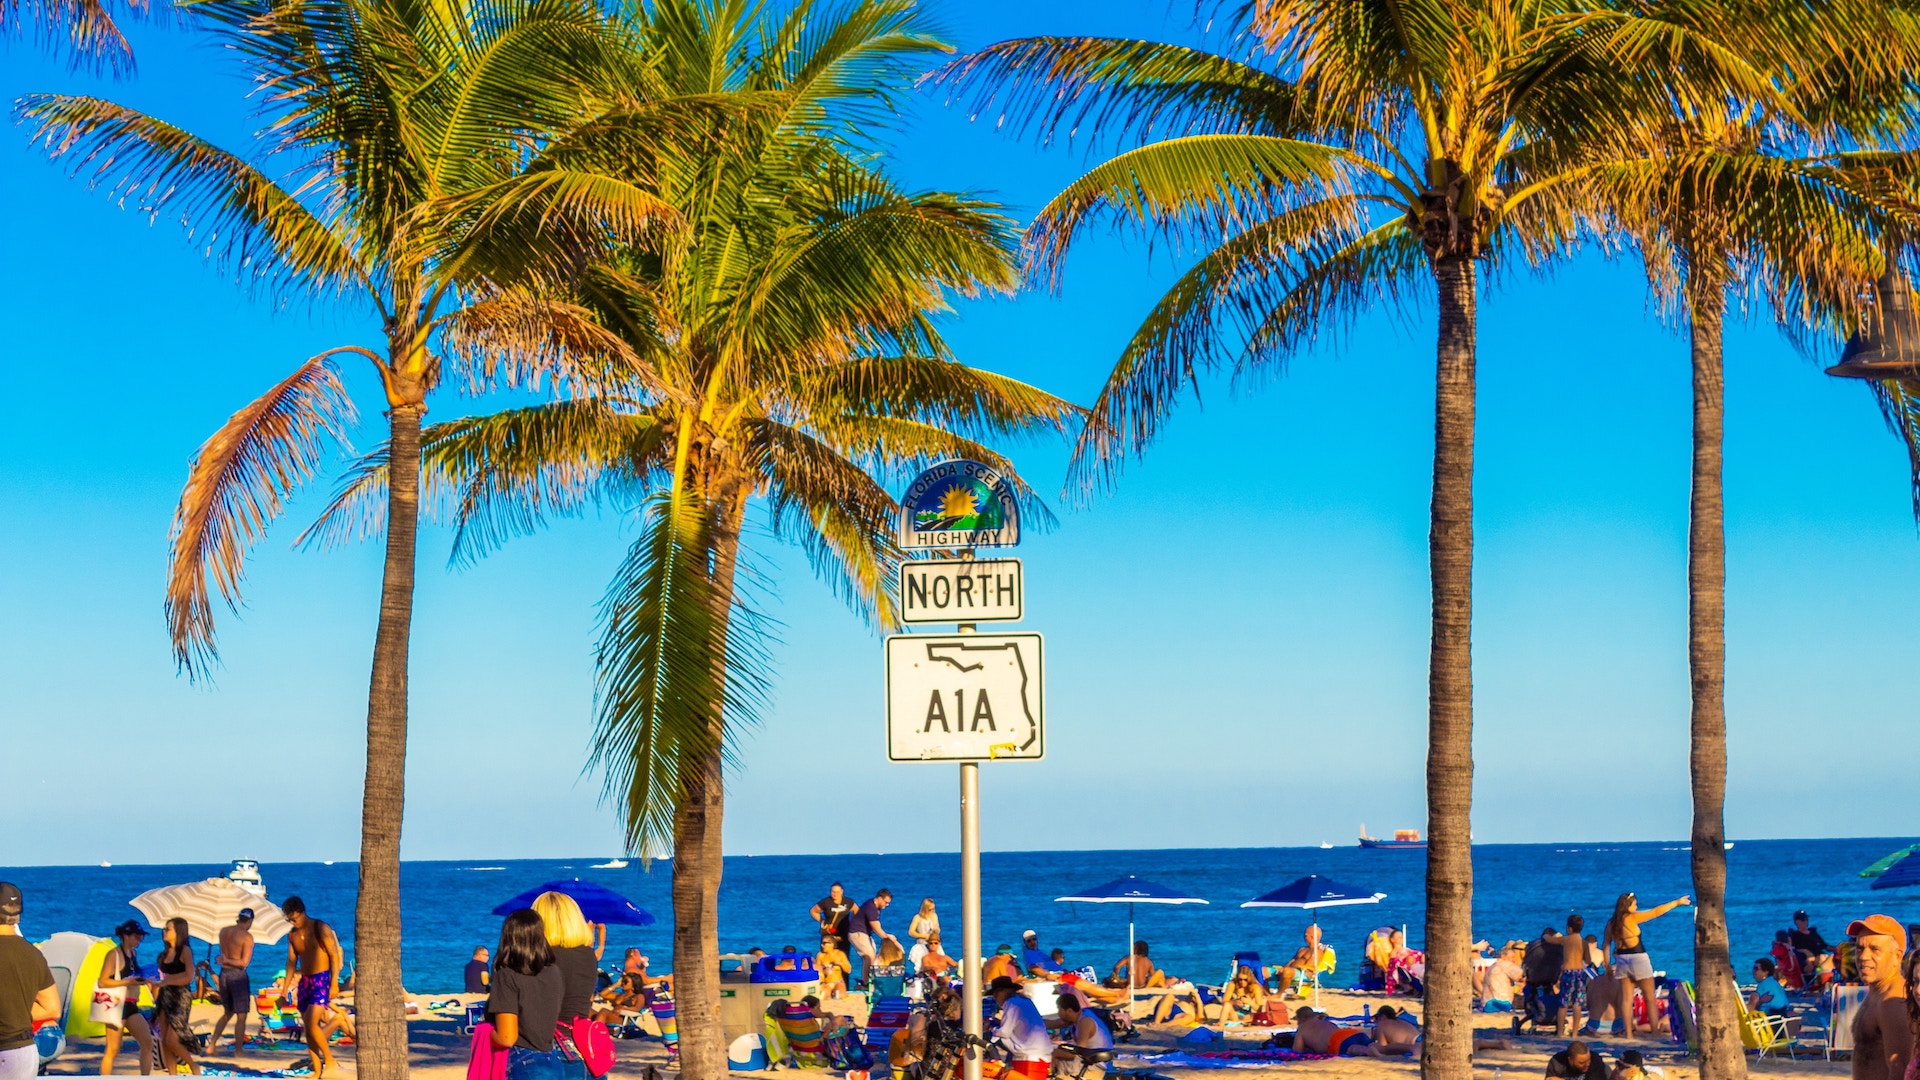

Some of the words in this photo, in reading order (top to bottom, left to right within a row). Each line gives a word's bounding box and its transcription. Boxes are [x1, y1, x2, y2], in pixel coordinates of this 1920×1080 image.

[905, 464, 957, 510] FLORIDA
[964, 463, 1012, 506] SCENIC
[917, 530, 1000, 545] HIGHWAY
[908, 573, 1015, 609] NORTH
[924, 688, 997, 733] A1A
